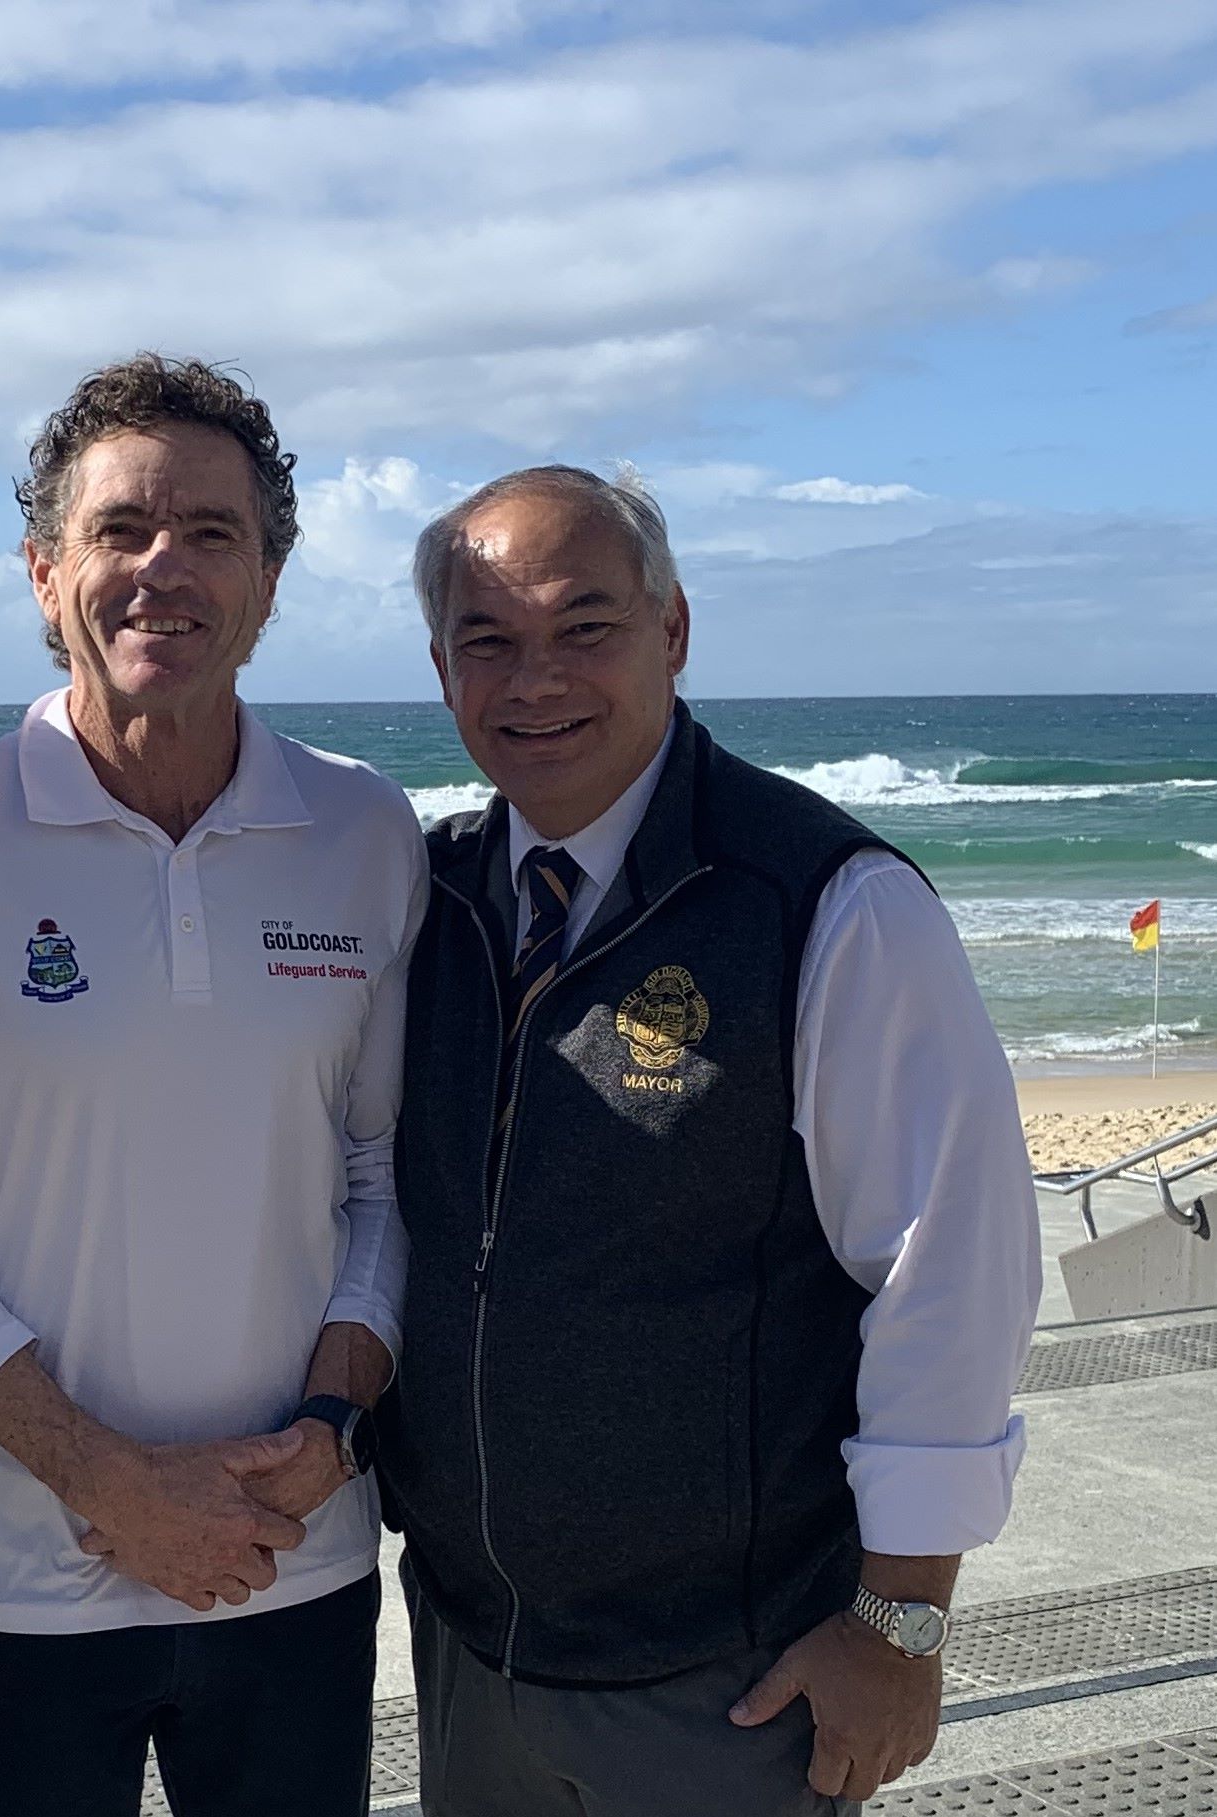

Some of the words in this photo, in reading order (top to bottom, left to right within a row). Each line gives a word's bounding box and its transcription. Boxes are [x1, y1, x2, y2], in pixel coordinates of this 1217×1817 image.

[262, 920, 280, 930] CITY
[283, 921, 294, 930] OF
[267, 962, 326, 979] Lifeguard
[329, 964, 367, 979] Service
[622, 1072, 683, 1093] MAYOR
